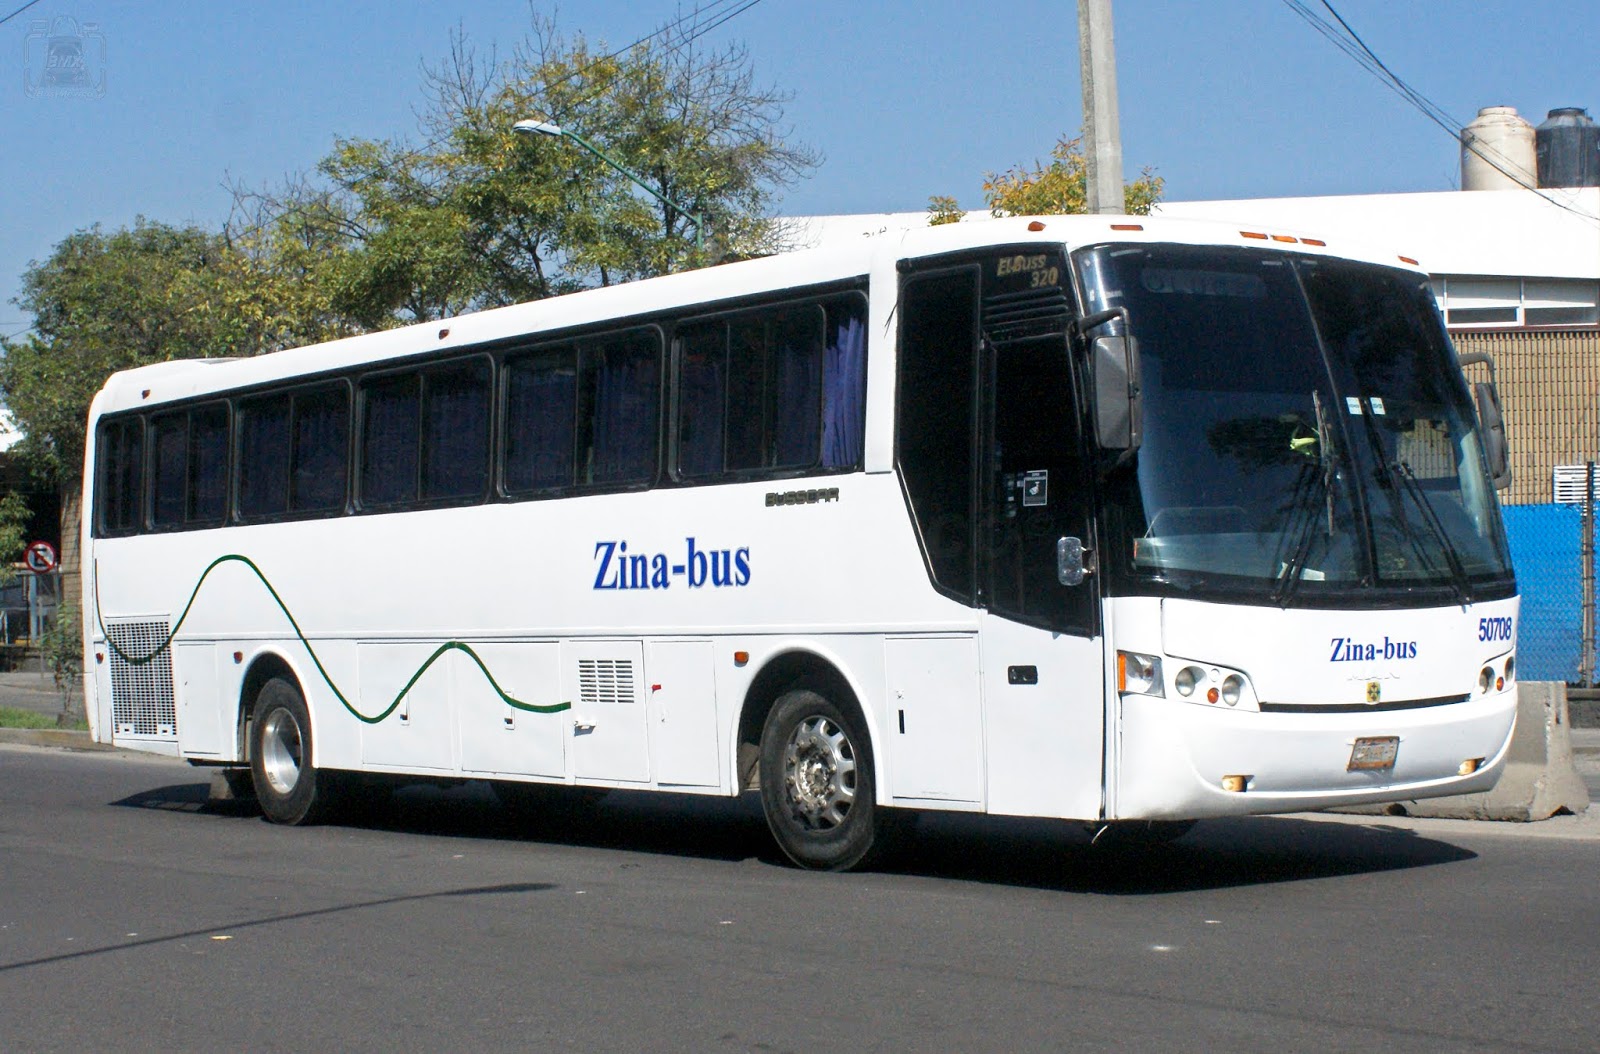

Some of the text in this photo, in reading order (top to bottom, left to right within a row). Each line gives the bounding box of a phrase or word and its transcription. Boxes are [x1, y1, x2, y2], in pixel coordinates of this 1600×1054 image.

[1031, 267, 1059, 288] 320
[593, 537, 751, 590] Zina-bus
[1478, 616, 1513, 642] 50708
[1330, 636, 1417, 662] Zina-bus
